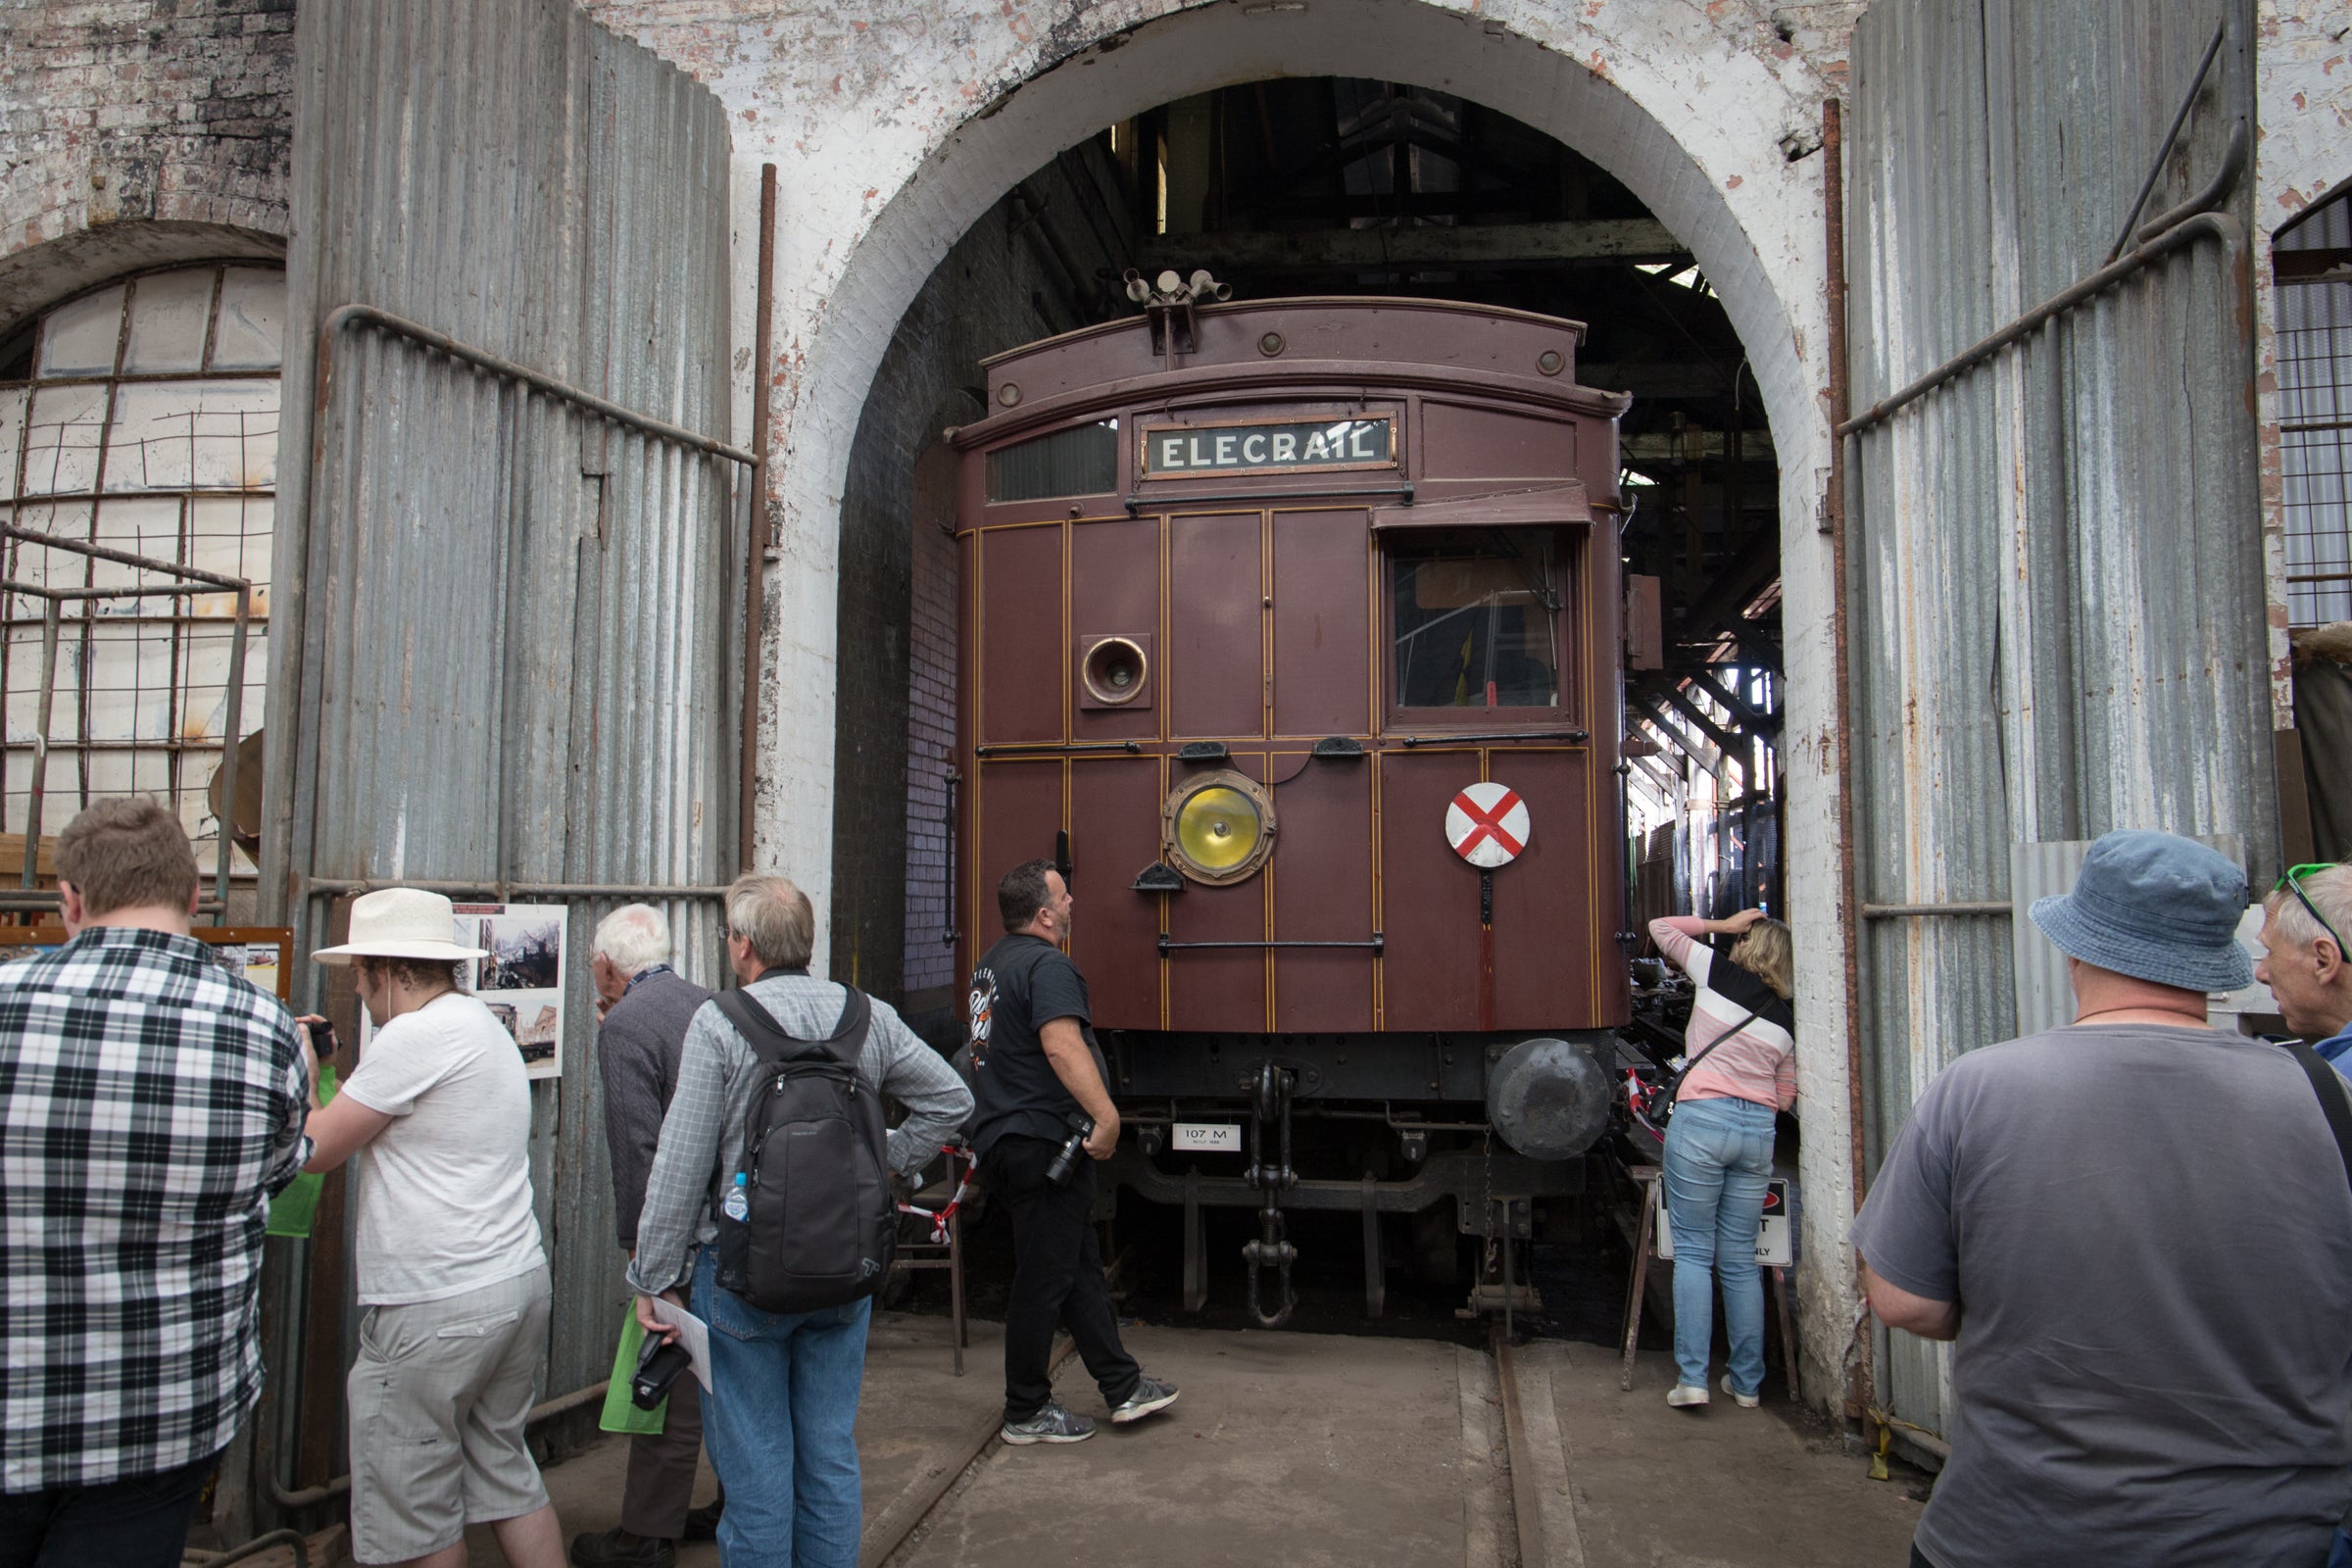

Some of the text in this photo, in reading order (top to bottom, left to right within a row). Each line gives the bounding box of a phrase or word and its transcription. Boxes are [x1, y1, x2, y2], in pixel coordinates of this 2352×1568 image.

[1162, 428, 1374, 467] ELECRAIL
[1185, 1129, 1227, 1139] 107 M
[1754, 1247, 1770, 1256] NLY
